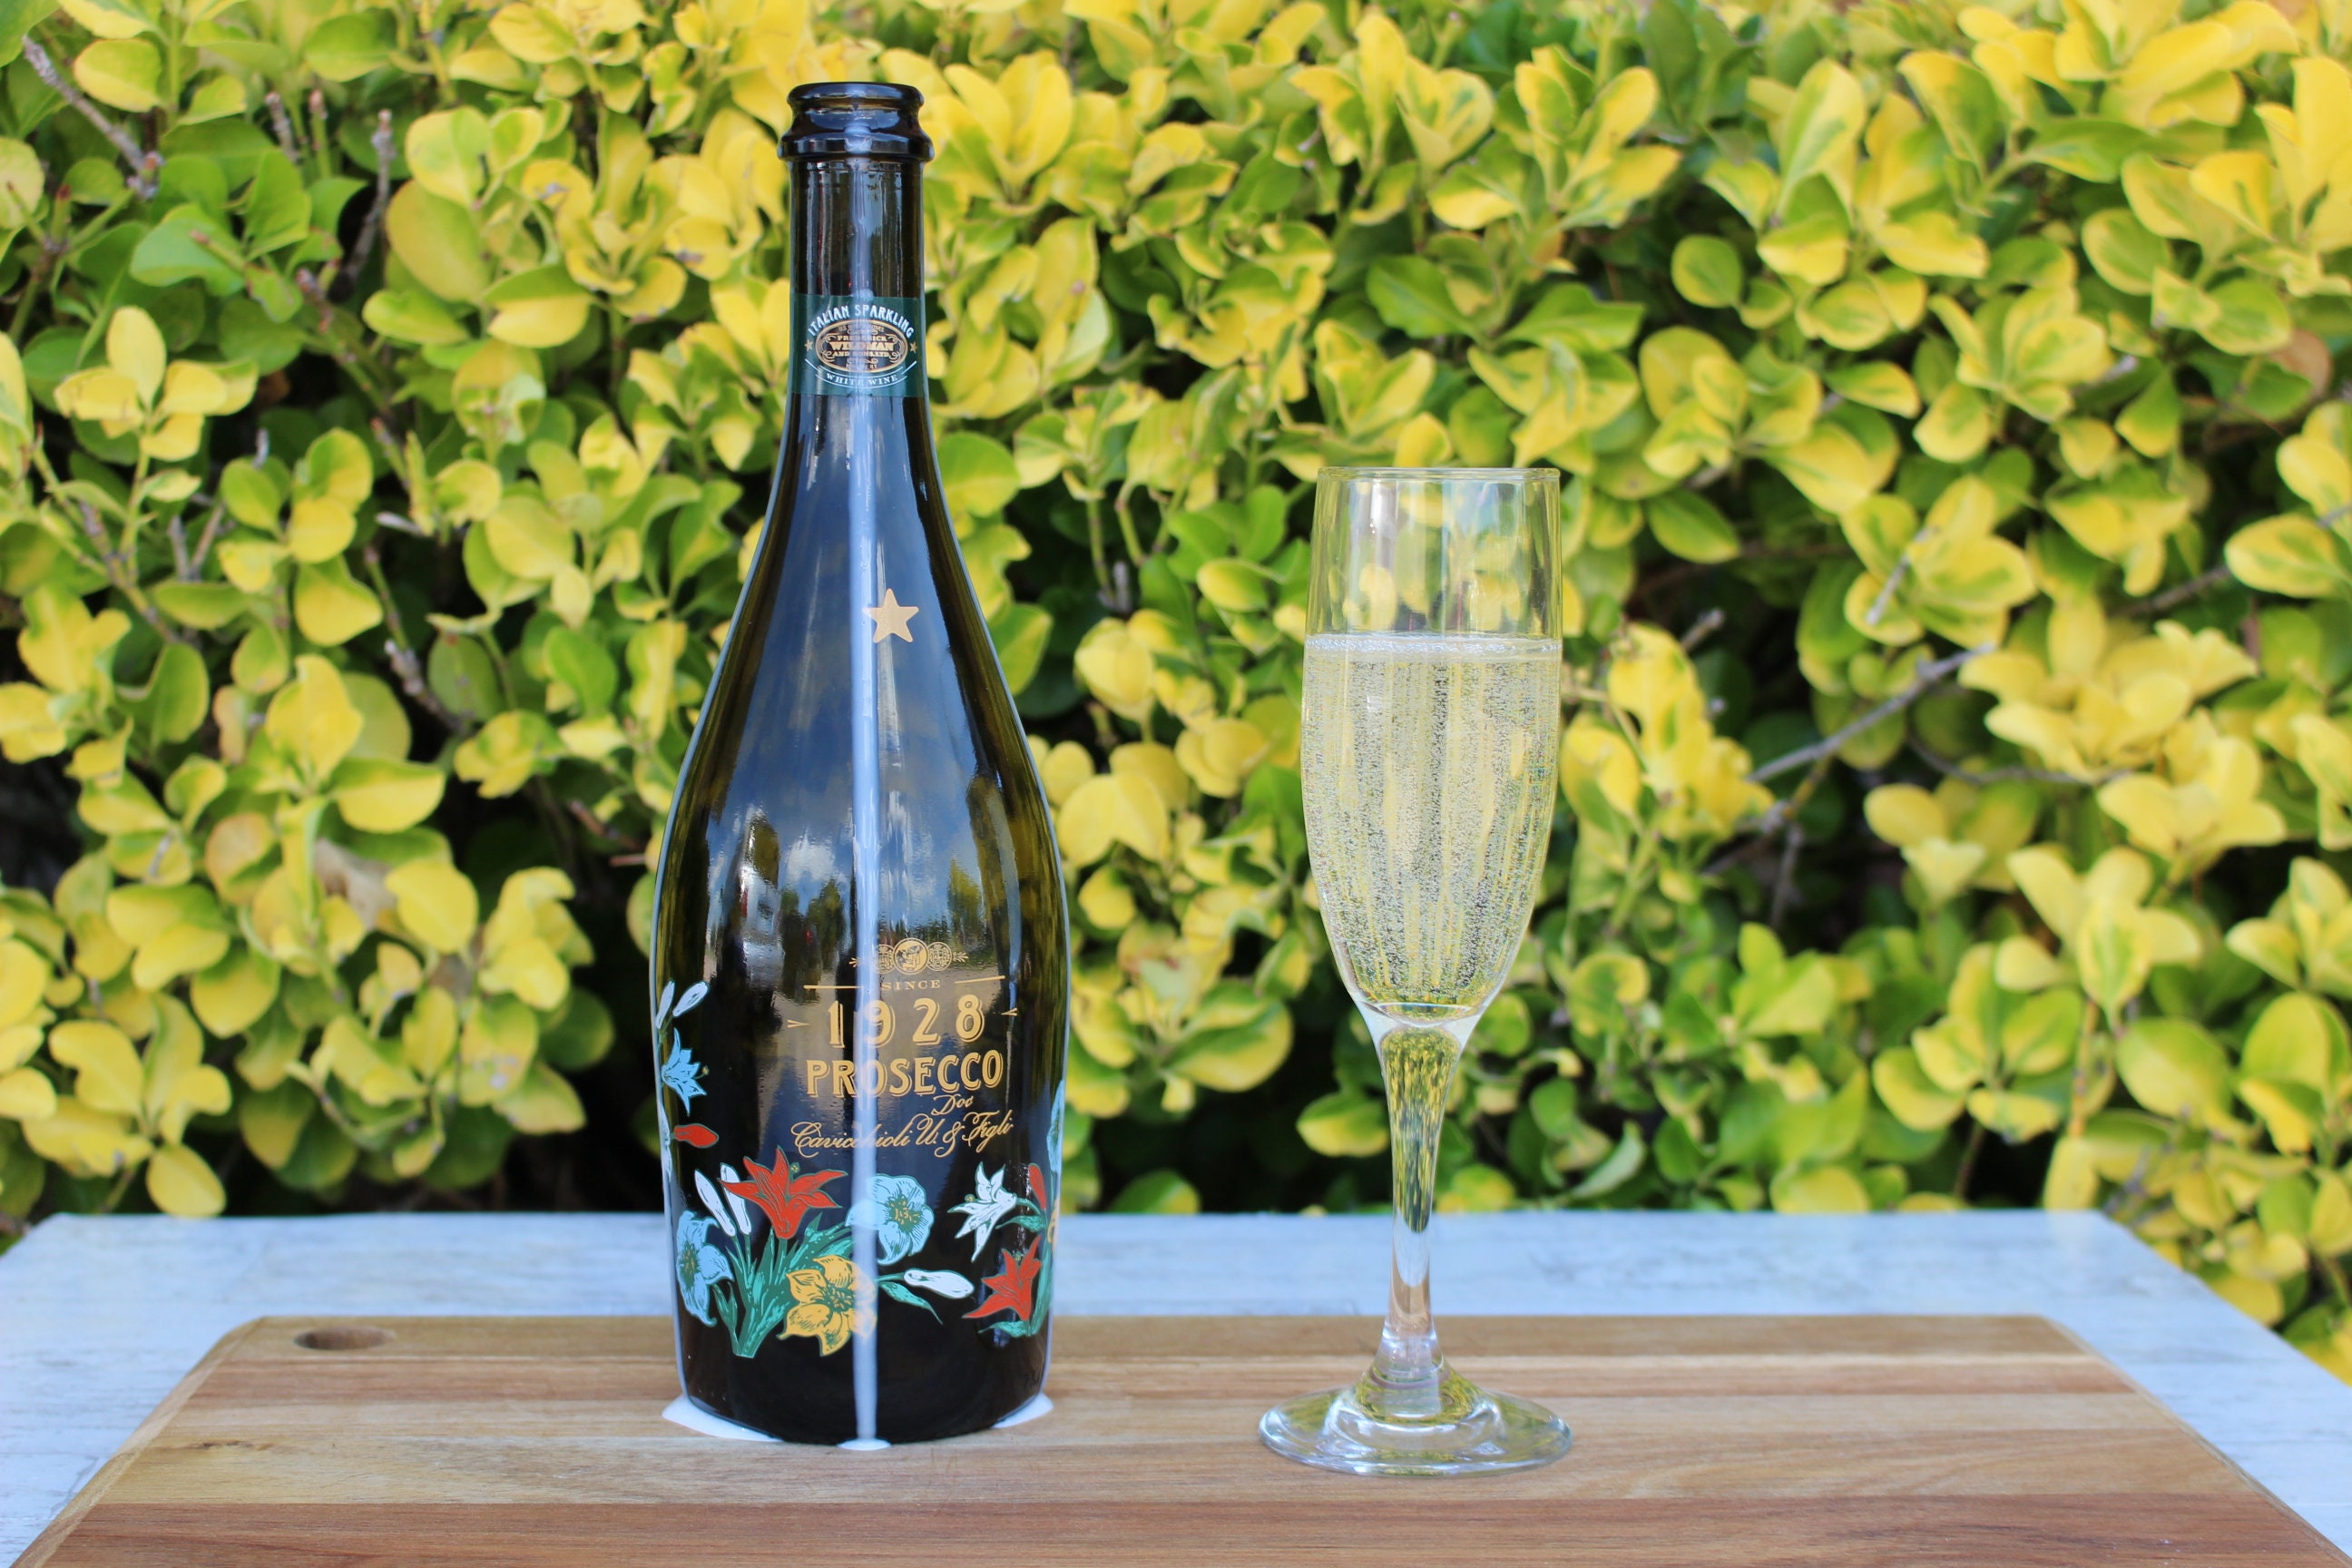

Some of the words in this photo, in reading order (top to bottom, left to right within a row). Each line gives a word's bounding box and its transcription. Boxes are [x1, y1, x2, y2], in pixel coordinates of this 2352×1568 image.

[808, 305, 850, 337] ITALIAN
[855, 304, 915, 338] SPARKLING
[827, 372, 865, 387] WHITE
[867, 373, 898, 386] WINE
[880, 979, 942, 992] SINCE
[828, 994, 985, 1049] 1928
[806, 1049, 1004, 1099] PROSECCO
[930, 1093, 975, 1116] Doc
[934, 1121, 965, 1158] &
[962, 1109, 1014, 1153] Figli
